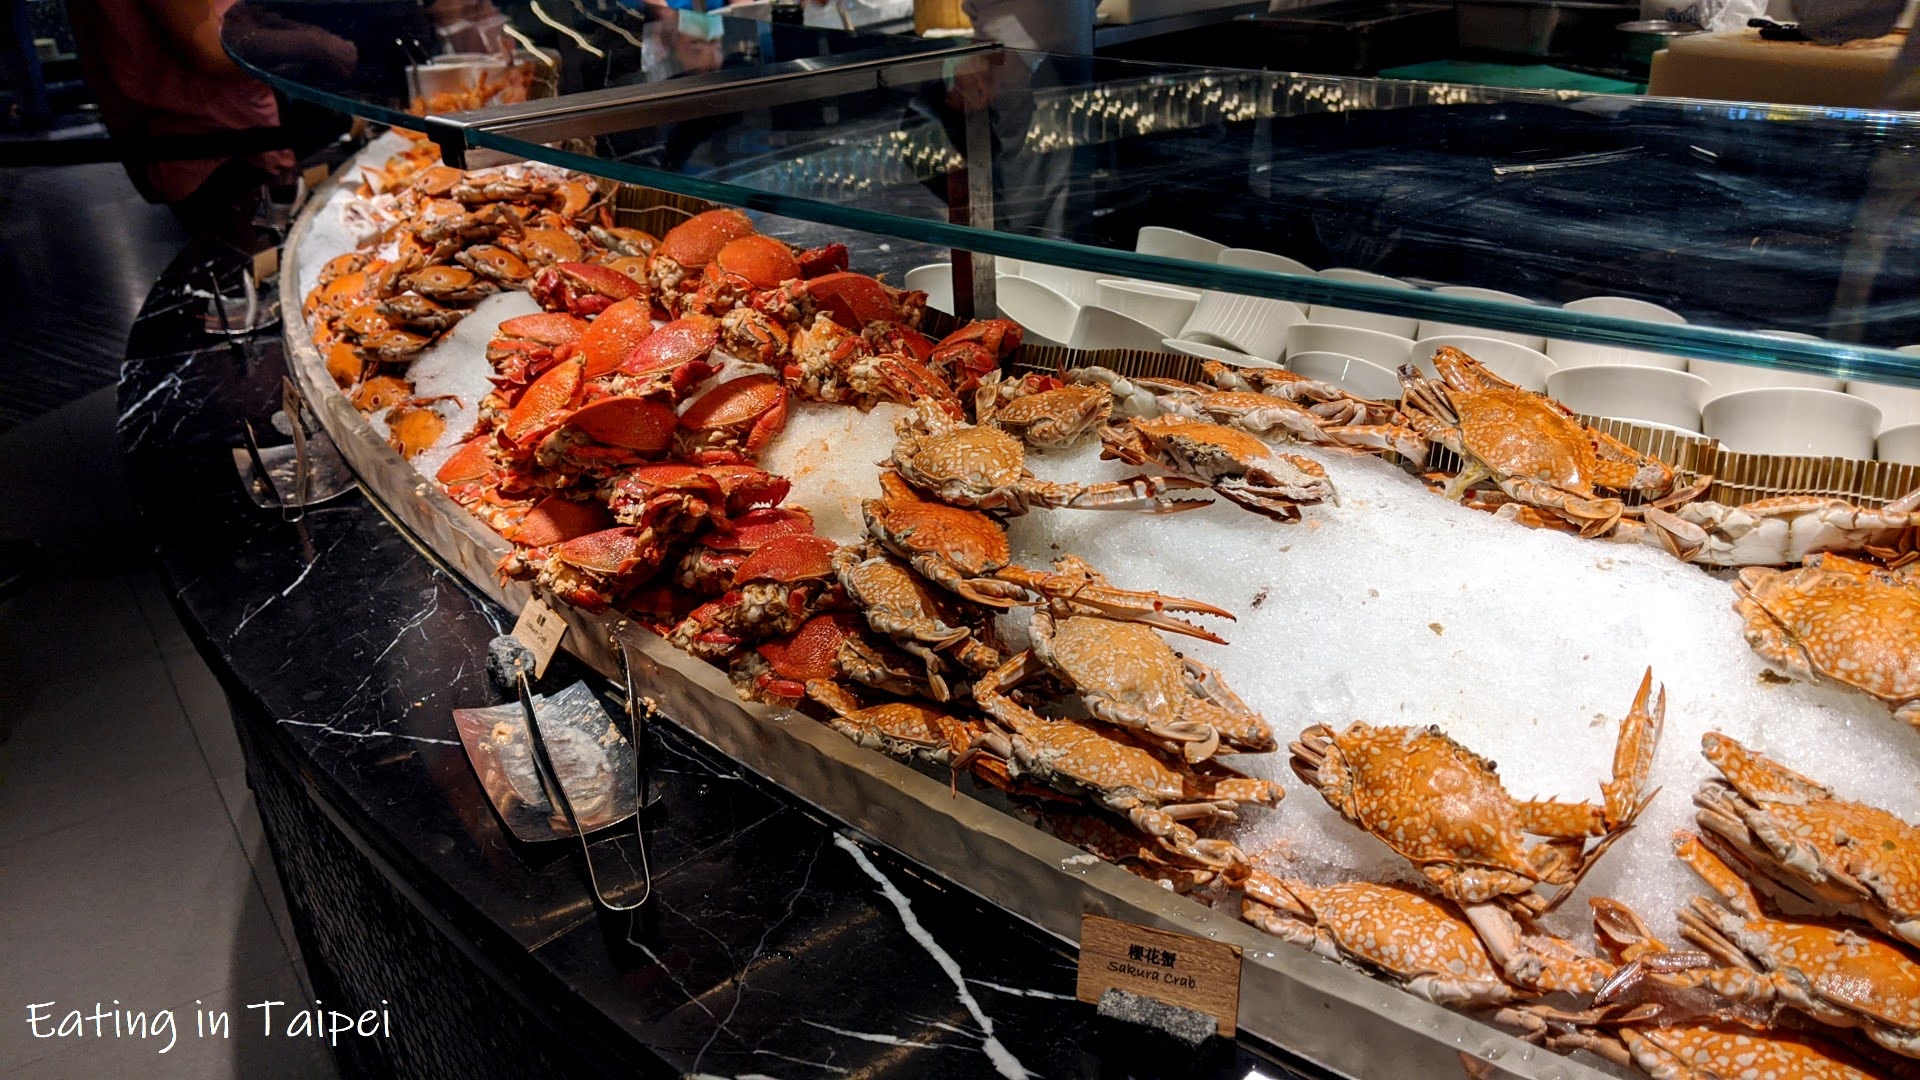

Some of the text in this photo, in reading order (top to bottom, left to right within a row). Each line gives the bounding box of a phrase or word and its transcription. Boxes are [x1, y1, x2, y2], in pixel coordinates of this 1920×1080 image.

[1128, 944, 1176, 968] 櫻花蟹
[1107, 961, 1196, 989] Sakura Crab
